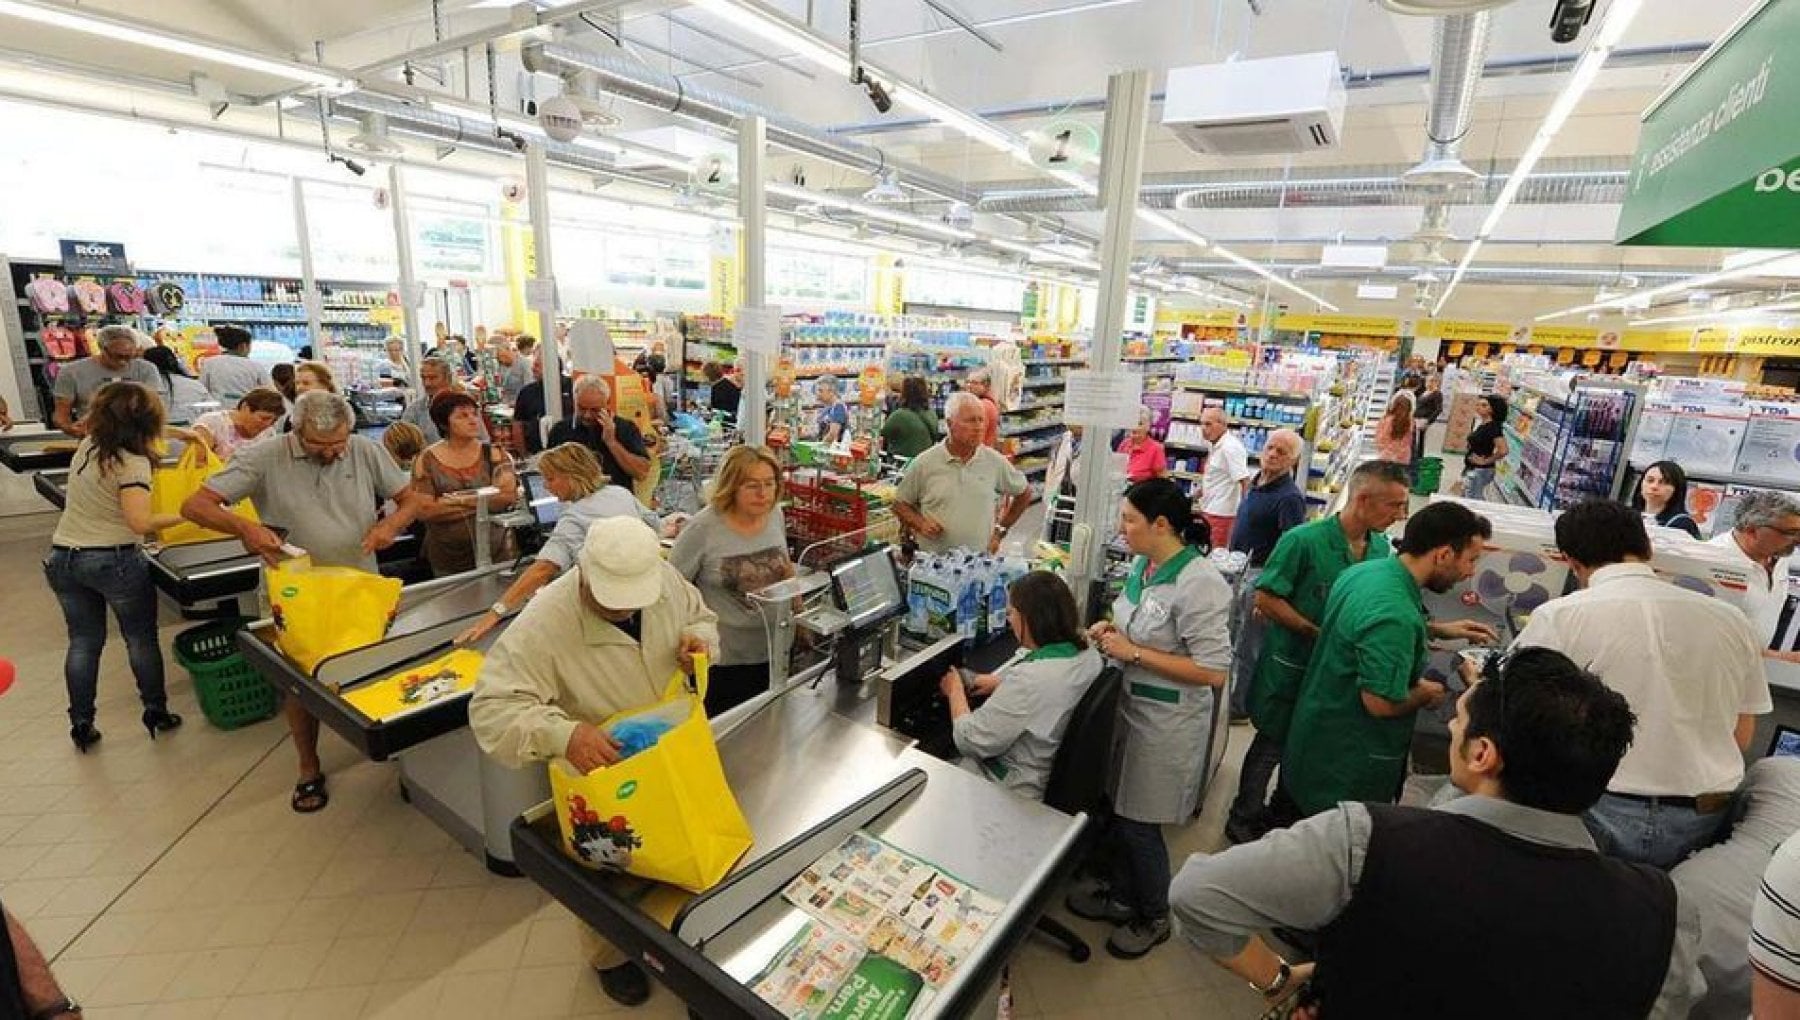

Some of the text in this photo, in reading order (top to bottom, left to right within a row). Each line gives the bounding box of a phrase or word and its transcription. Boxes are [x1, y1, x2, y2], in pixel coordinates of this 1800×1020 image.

[1714, 54, 1774, 132] clienti
[1049, 129, 1071, 163] 1
[708, 158, 721, 184] 2
